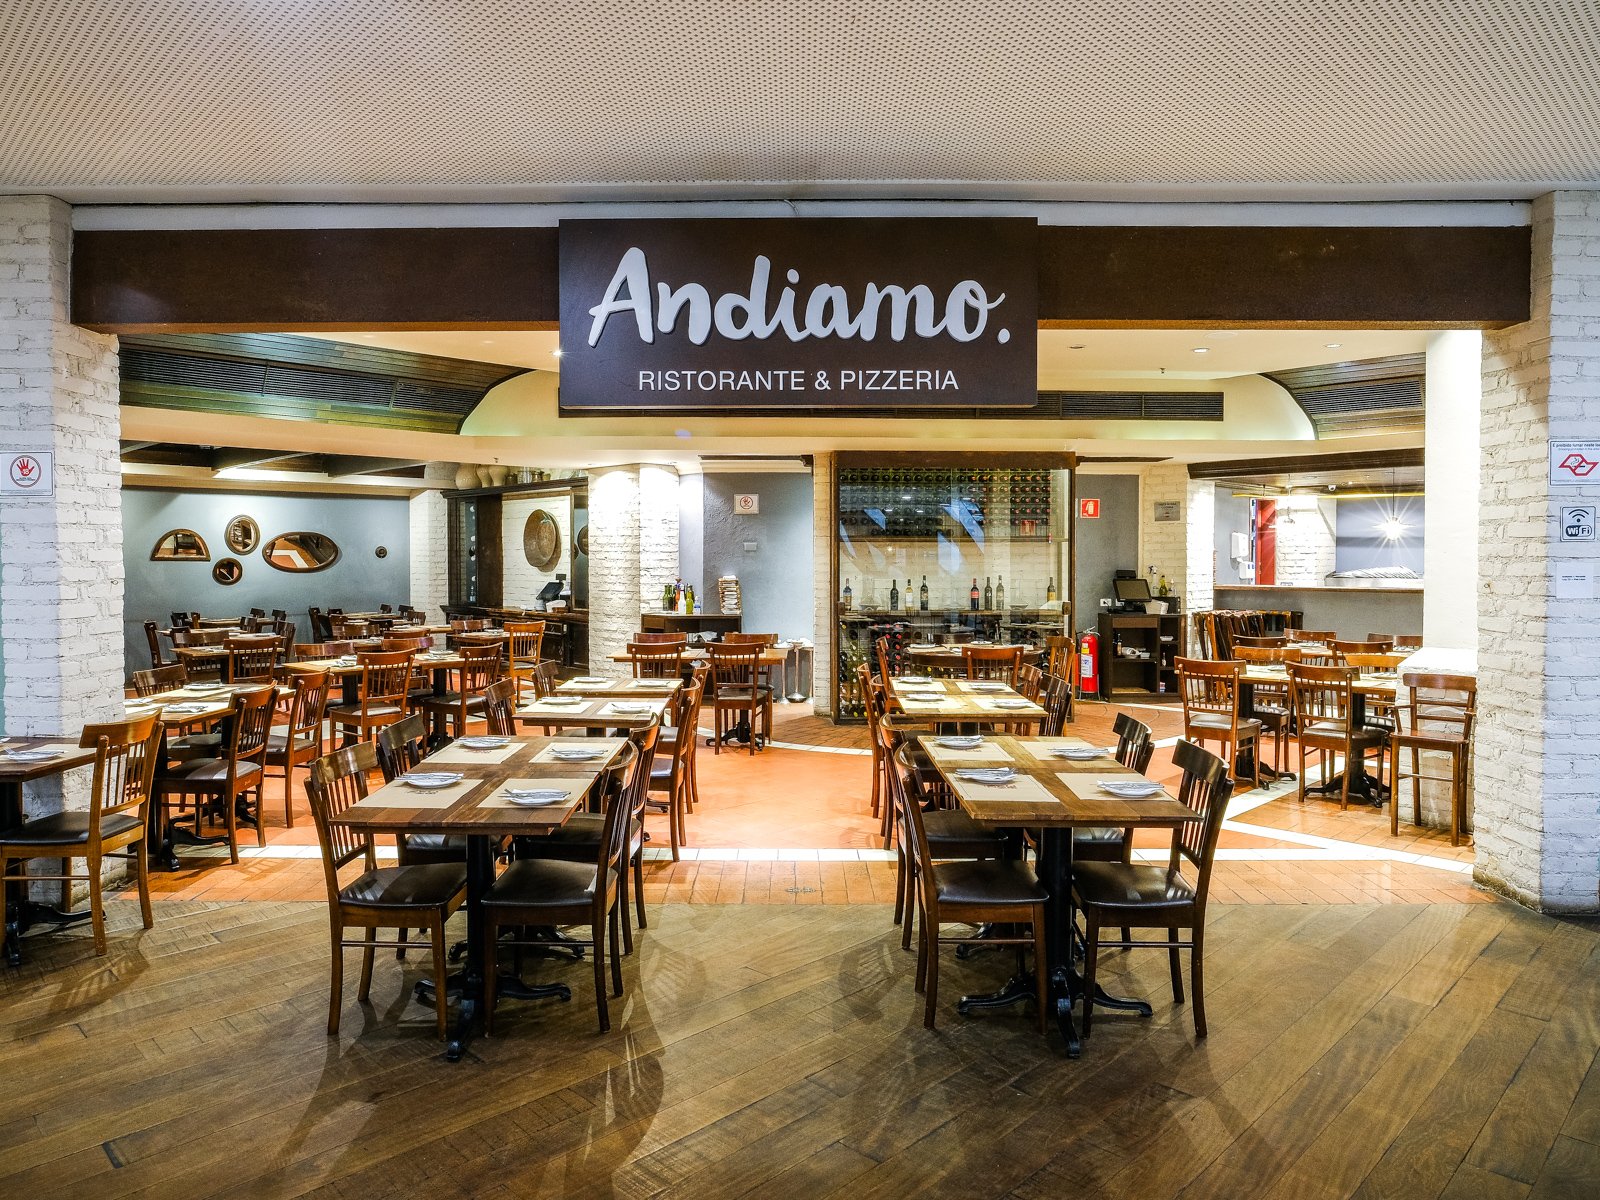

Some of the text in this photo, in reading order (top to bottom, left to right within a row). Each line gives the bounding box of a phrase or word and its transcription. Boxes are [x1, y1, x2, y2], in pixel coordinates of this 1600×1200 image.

[638, 371, 959, 391] RISTORANTE & PIZZERIA
